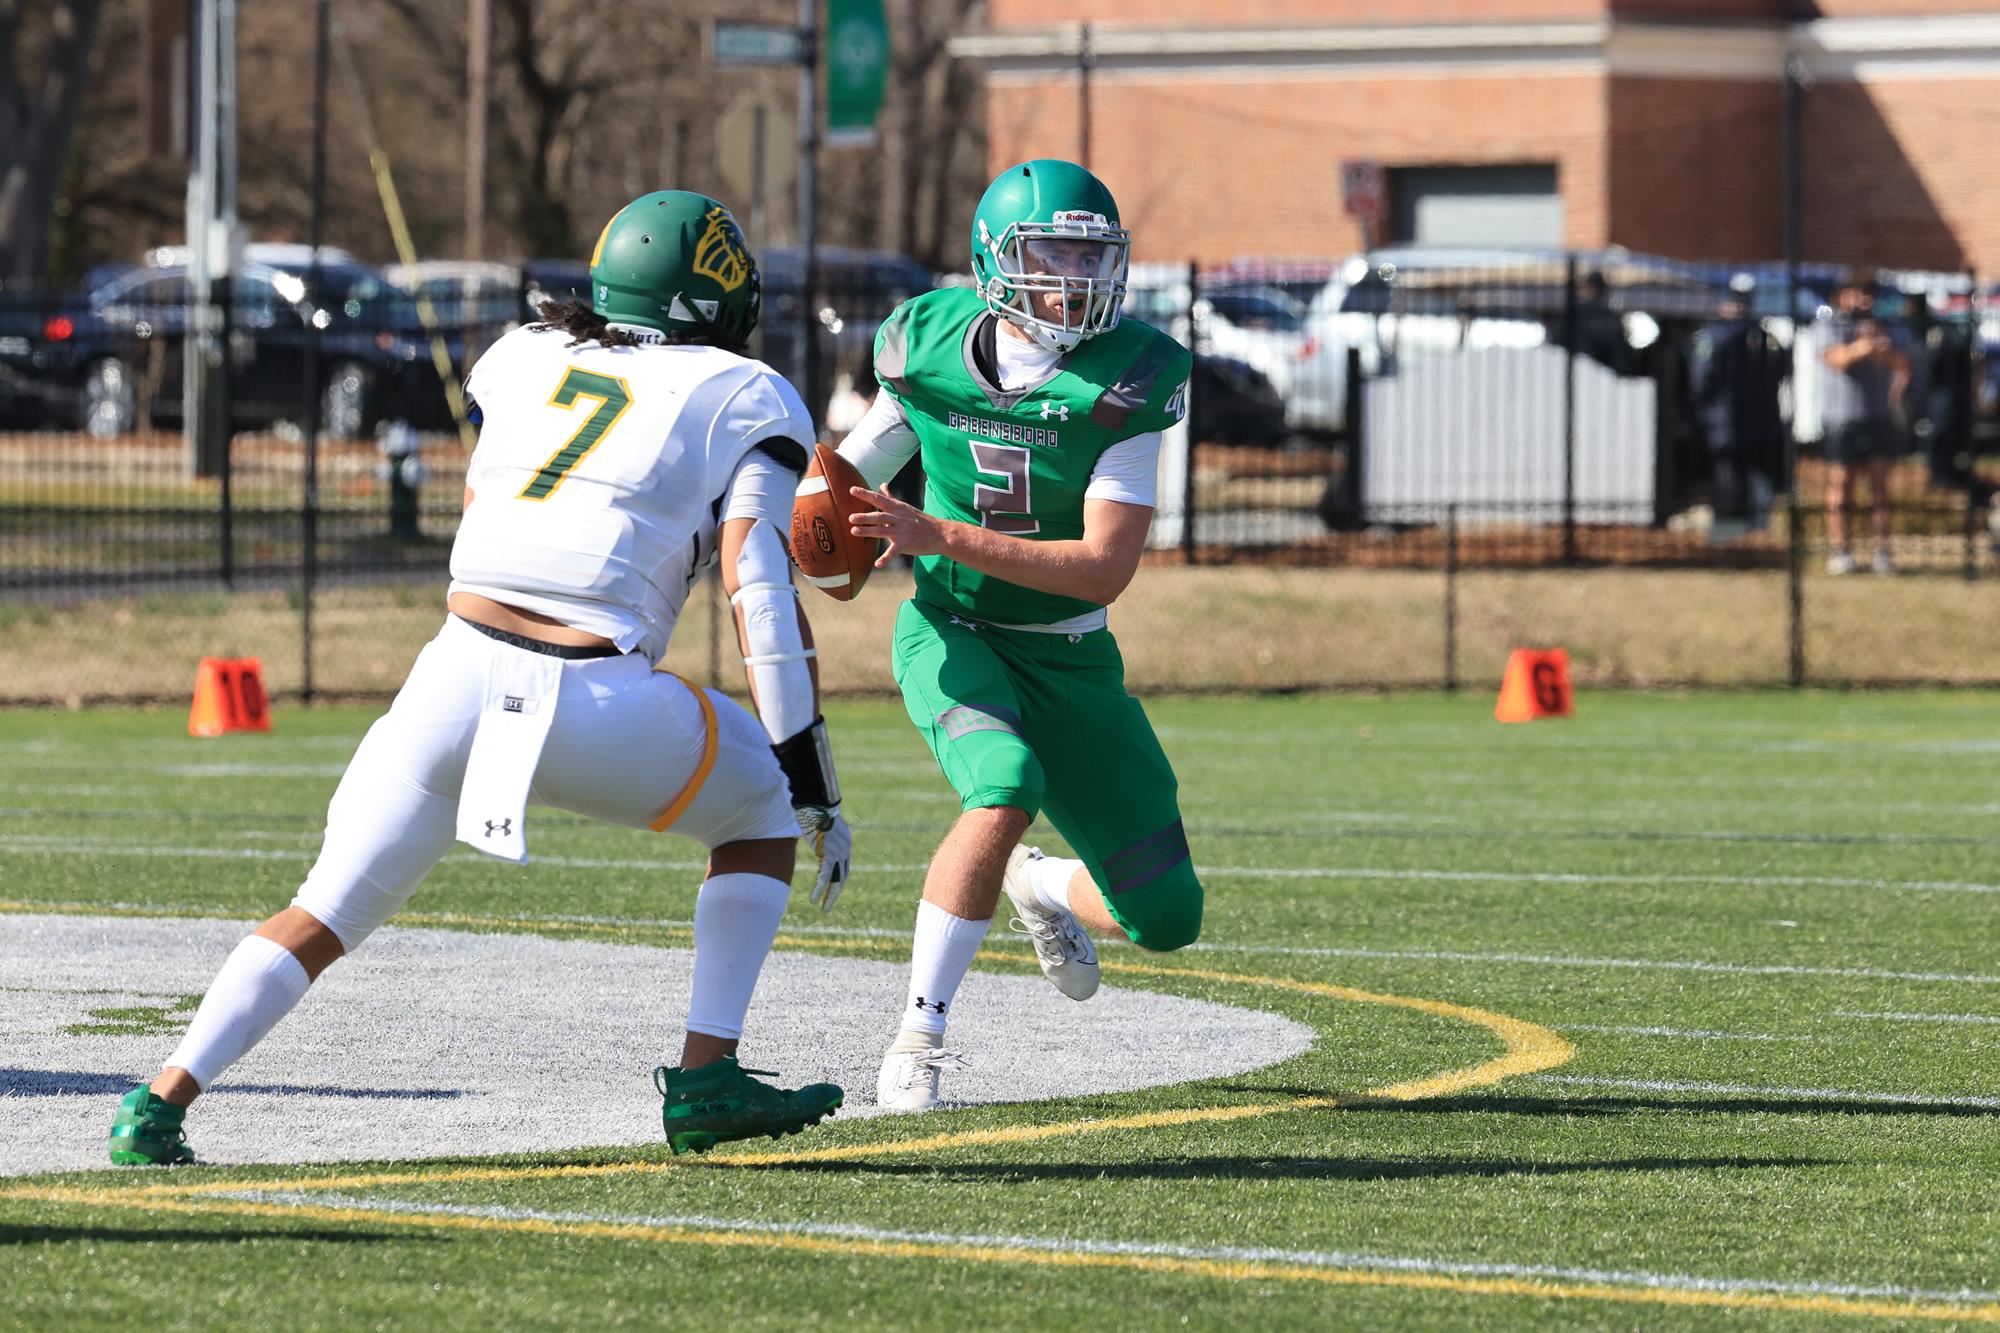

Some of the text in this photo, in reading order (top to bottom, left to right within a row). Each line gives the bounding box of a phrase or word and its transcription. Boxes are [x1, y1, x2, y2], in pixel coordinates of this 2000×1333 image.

[1066, 213, 1094, 222] Riddell
[514, 365, 635, 502] 7
[948, 411, 1058, 447] GREENSBORO
[968, 440, 1040, 534] 2
[815, 518, 831, 552] GST
[220, 669, 262, 720] 10
[1533, 662, 1562, 715] G
